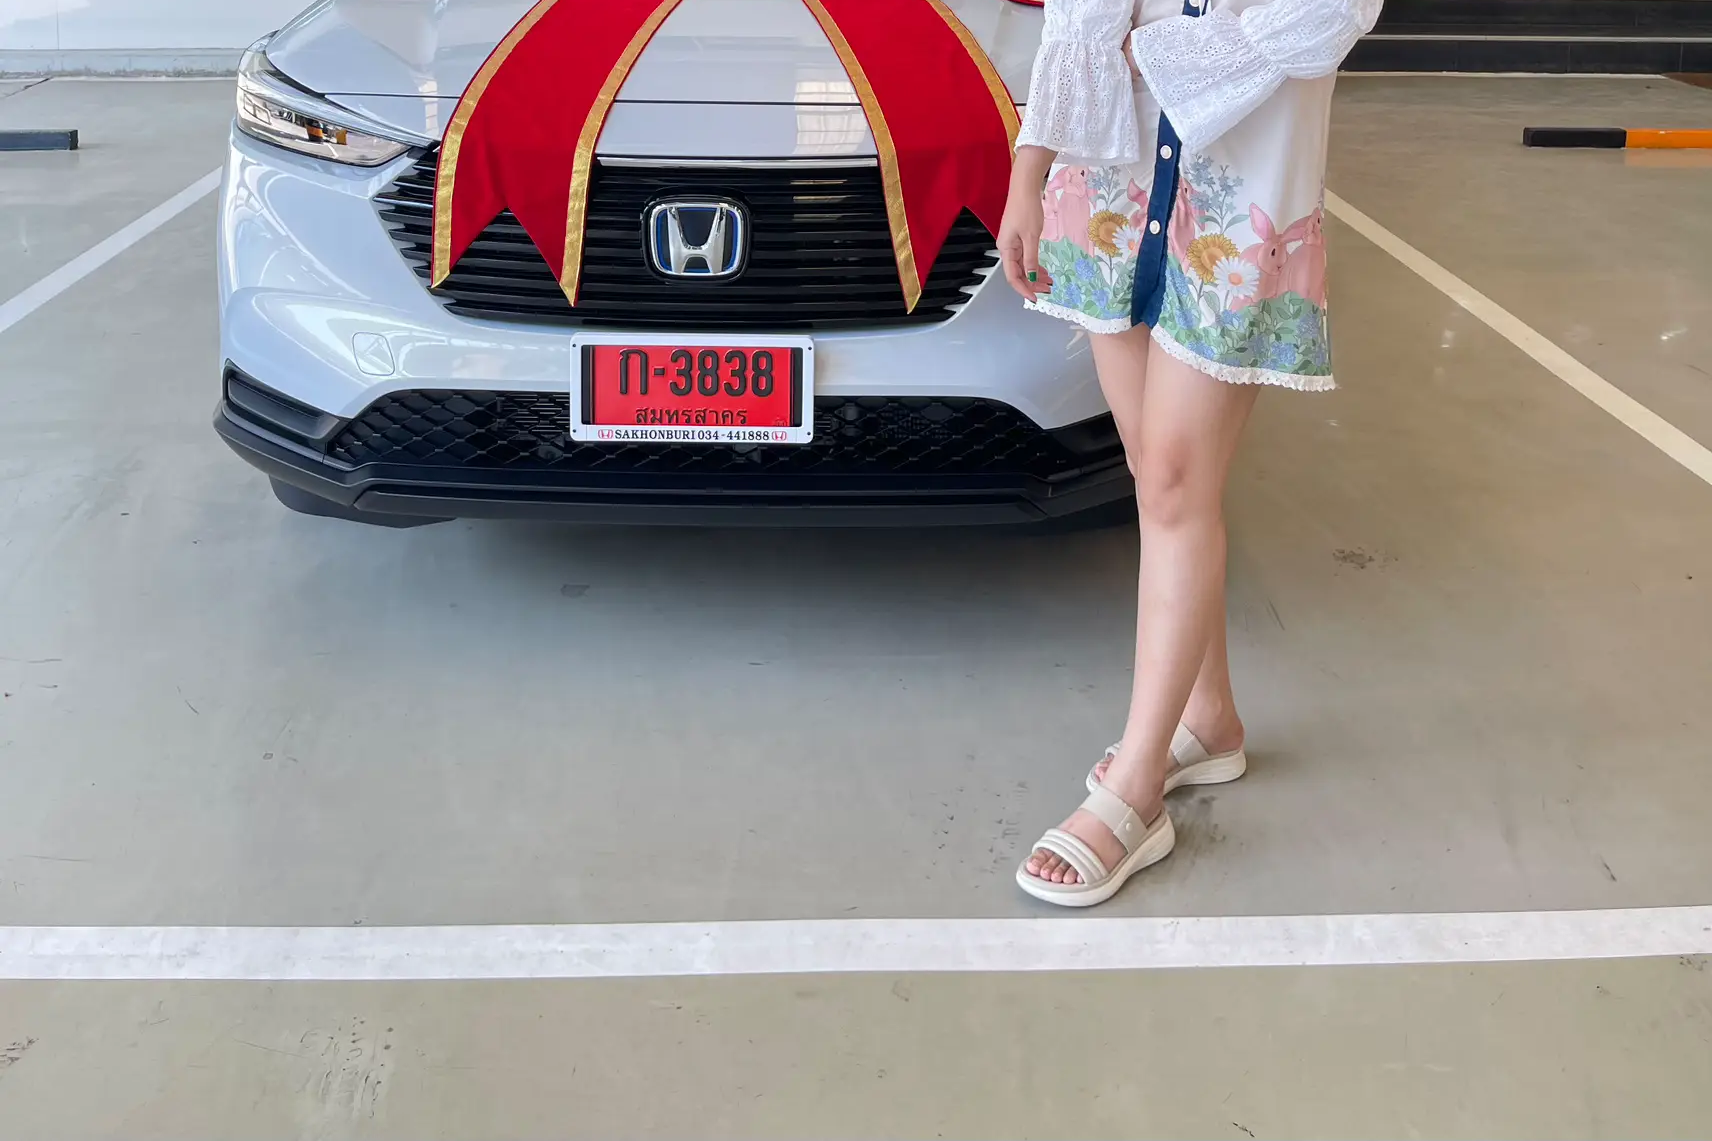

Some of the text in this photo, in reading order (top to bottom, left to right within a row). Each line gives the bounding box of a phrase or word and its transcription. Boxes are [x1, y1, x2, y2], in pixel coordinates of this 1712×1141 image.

[635, 407, 748, 425] สมทรสาคร
[614, 429, 770, 441] SAKHONBURI 034-441888
